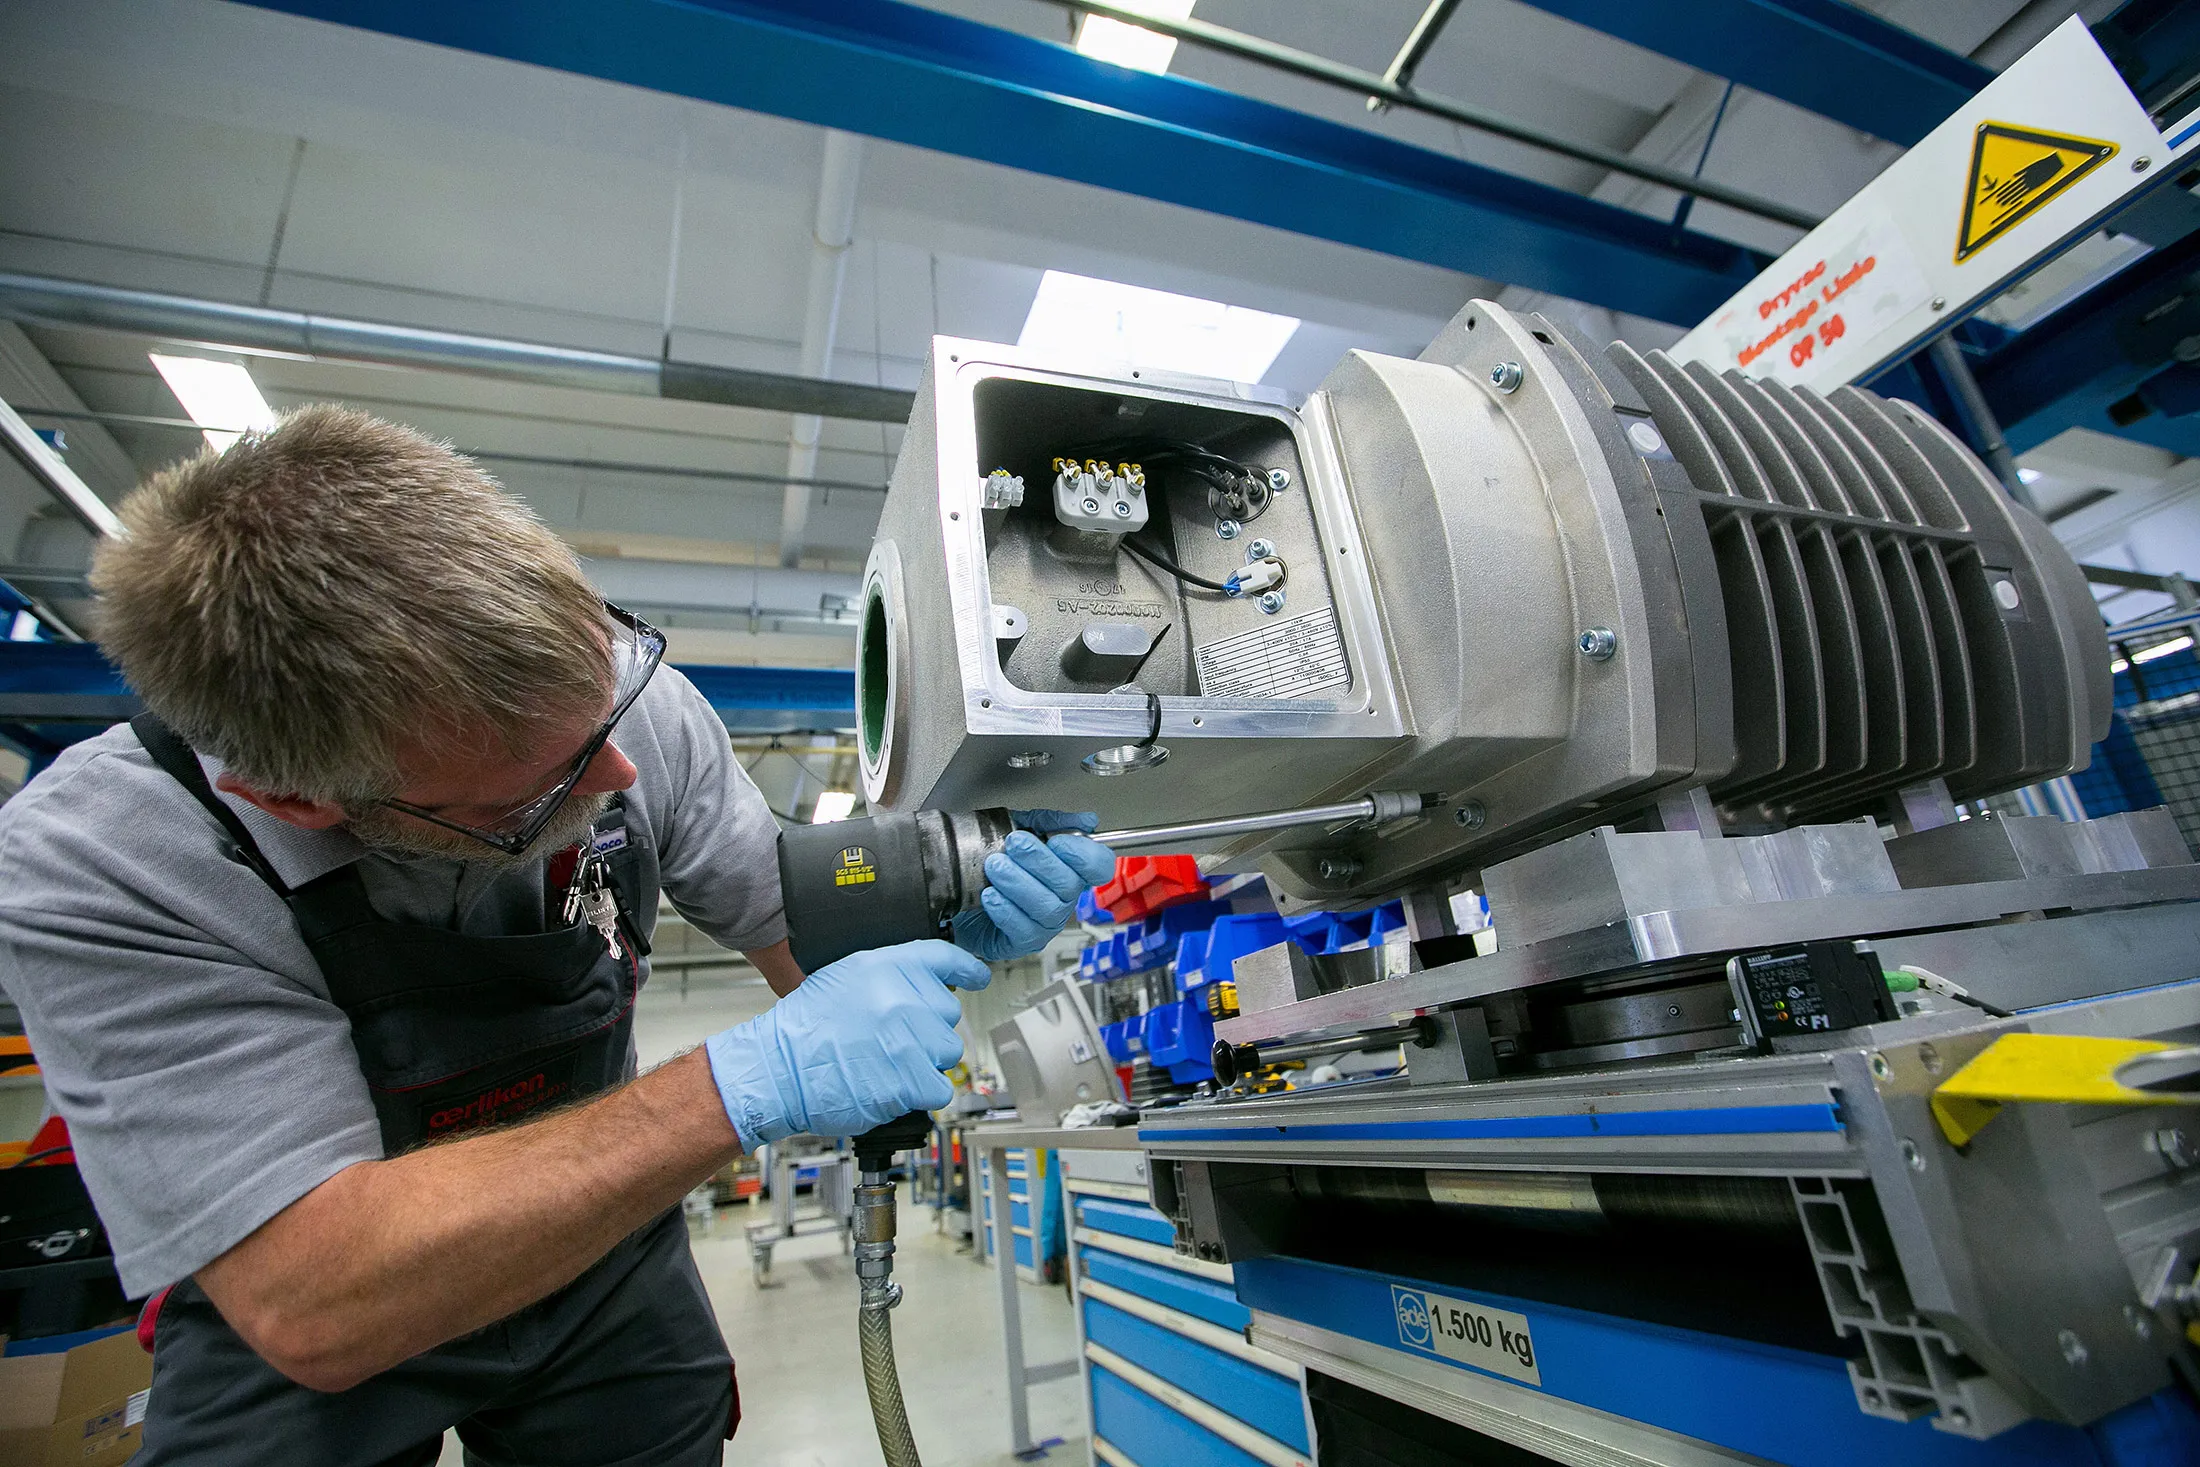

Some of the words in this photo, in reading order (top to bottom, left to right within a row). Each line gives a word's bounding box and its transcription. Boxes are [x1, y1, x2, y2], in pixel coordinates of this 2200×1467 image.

[1790, 334, 1815, 368] OP
[1819, 313, 1846, 347] 50
[1399, 1307, 1430, 1329] ade
[1432, 1304, 1492, 1348] 1.500
[1497, 1319, 1534, 1368] kg
